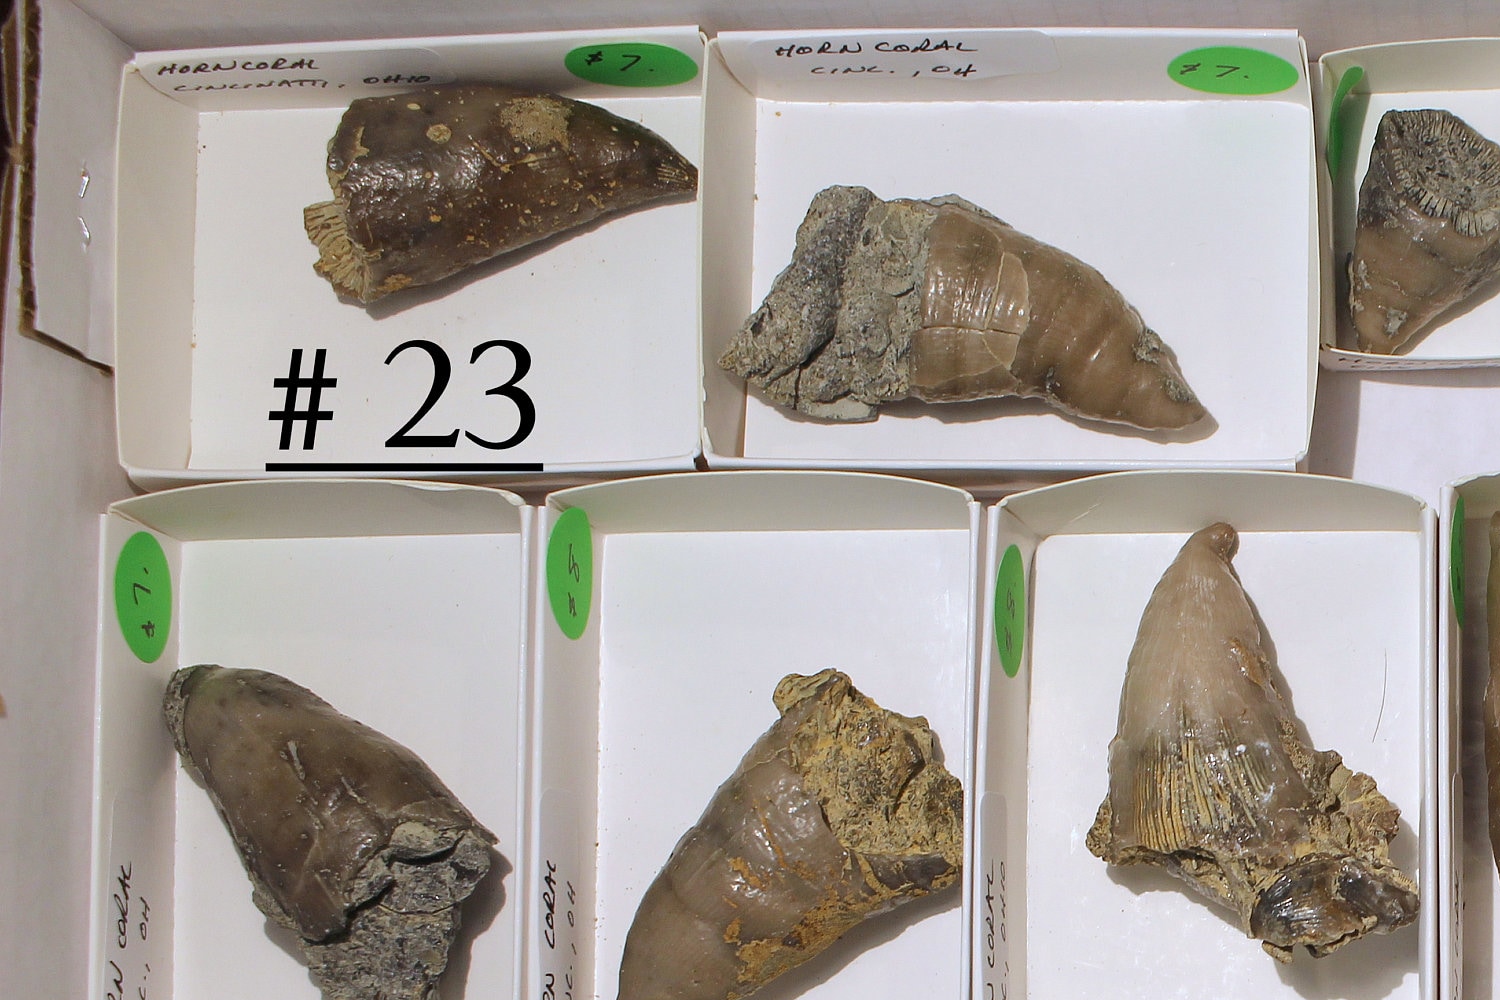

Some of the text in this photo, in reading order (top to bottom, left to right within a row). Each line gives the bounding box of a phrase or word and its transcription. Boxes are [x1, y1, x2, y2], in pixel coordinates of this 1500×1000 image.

[774, 37, 979, 58] HORN CORAL
[362, 73, 432, 85] OHIO
[113, 860, 133, 949] CORAL
[139, 896, 151, 941] OH
[542, 859, 557, 949] CORAL
[566, 880, 576, 928] OH
[984, 858, 996, 968] CORAL
